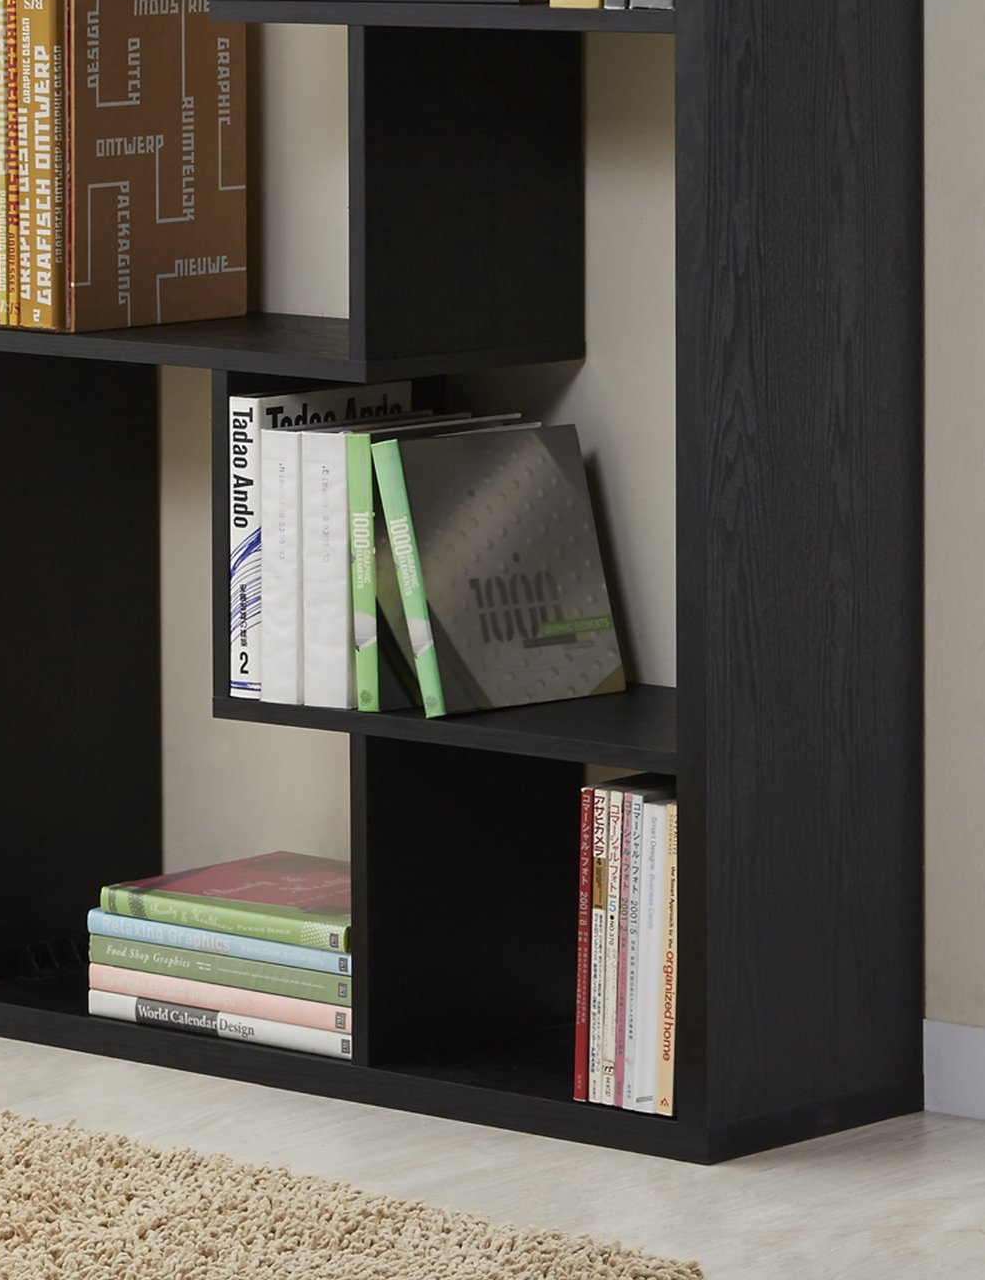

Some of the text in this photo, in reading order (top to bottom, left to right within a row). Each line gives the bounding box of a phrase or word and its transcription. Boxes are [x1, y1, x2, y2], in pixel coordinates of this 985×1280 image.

[21, 17, 31, 104] GRAPHIC DESIGN
[87, 11, 100, 89] DESIGN
[128, 37, 141, 105] DUTCH
[217, 37, 231, 125] GRAPHIC
[34, 45, 53, 306] GRAFISCH ONTWERP
[95, 134, 165, 157] ONTWERP
[182, 96, 195, 221] RUIMTELIJK
[117, 181, 130, 305] PACKAGING
[174, 255, 229, 277] NIEUWE
[232, 407, 255, 528] Tadao Ando
[353, 511, 370, 549] 1000
[390, 516, 413, 556] 1000
[239, 651, 249, 674] 2
[594, 796, 605, 857] アサヒカメラ
[102, 916, 231, 952] Relaxing Graphics
[106, 944, 191, 969] Food Shop Graphics
[137, 1004, 255, 1038] World Calendar Design
[662, 950, 675, 1061] organized home
